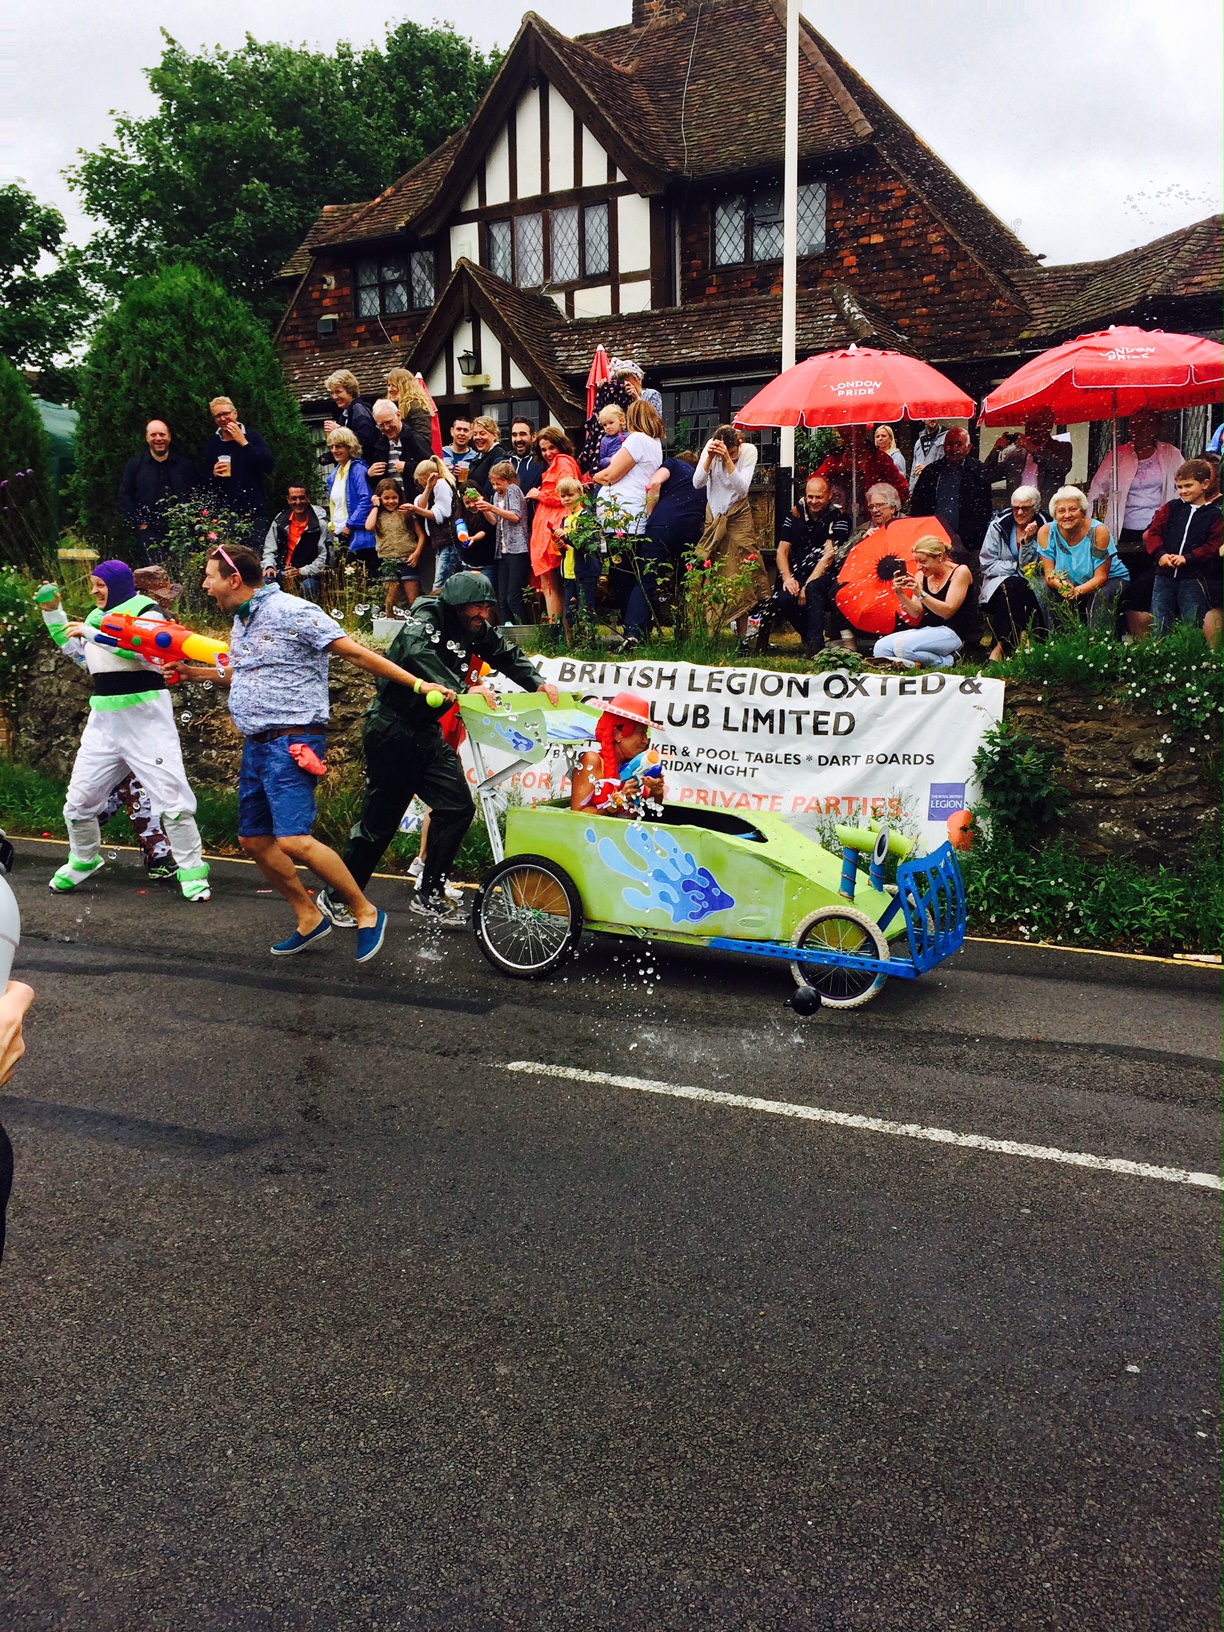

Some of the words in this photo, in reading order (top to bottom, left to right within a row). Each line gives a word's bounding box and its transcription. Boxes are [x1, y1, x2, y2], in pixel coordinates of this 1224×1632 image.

[831, 381, 882, 391] LONDON
[837, 388, 875, 397] PRIDE
[558, 662, 678, 691] BRITISH
[688, 668, 811, 698] LEGION
[823, 674, 946, 698] OXTED
[959, 677, 983, 695] &
[650, 700, 710, 729] LUB
[723, 706, 856, 736] LIMITED
[681, 746, 691, 757] &
[696, 747, 739, 761] POOL
[745, 751, 801, 765] TABLES
[818, 755, 861, 766] DART
[865, 753, 935, 765] BOARDS
[660, 759, 702, 773] RIDAY
[706, 763, 759, 778] NIGHT
[679, 787, 784, 812] PRIVATE
[930, 799, 963, 809] LEGION
